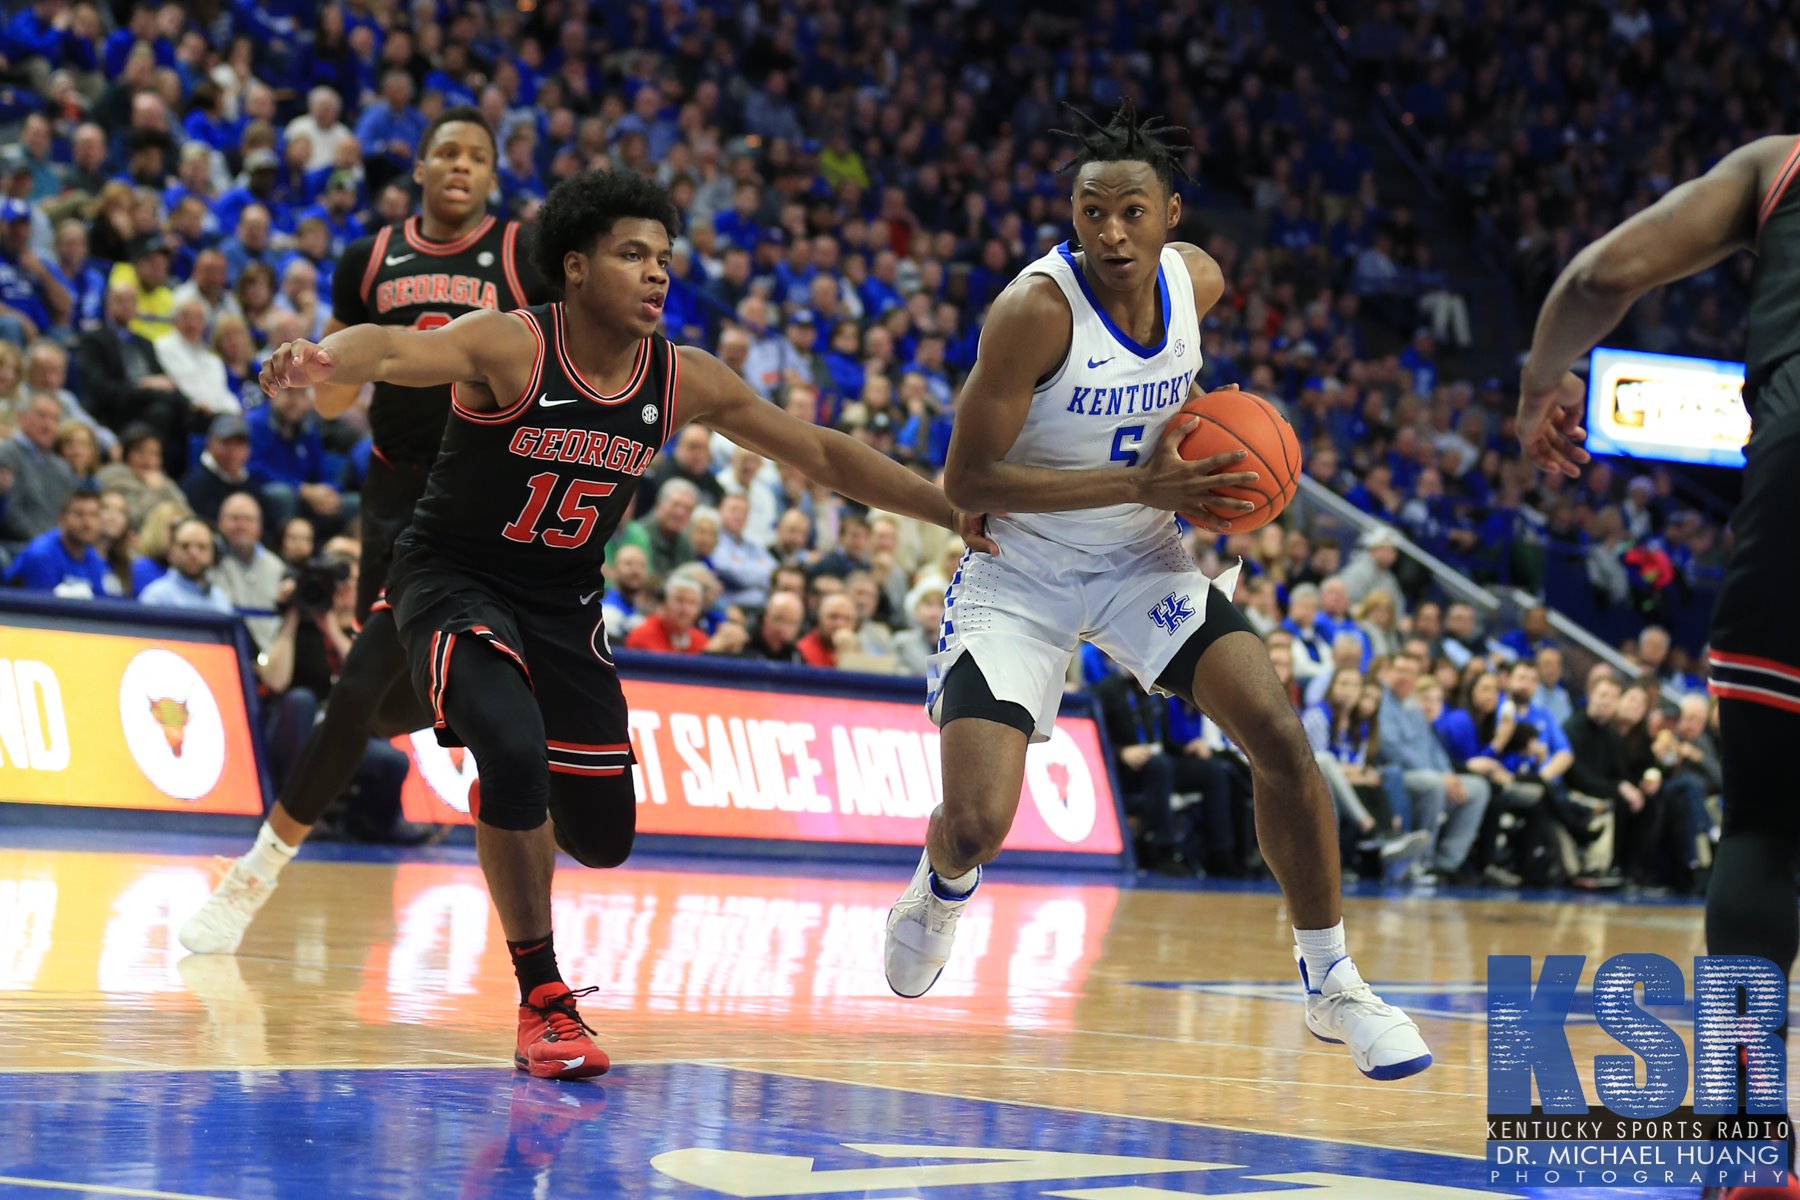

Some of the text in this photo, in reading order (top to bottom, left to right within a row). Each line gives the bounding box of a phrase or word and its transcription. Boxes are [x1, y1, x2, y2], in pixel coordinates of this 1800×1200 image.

[377, 273, 499, 313] GEORGIA
[1067, 368, 1193, 416] KENTUCKY
[509, 426, 655, 476] GEORGIA
[1110, 425, 1145, 467] 5
[502, 472, 618, 549] 15
[1147, 591, 1196, 636] UK
[669, 712, 832, 813] SAUCE
